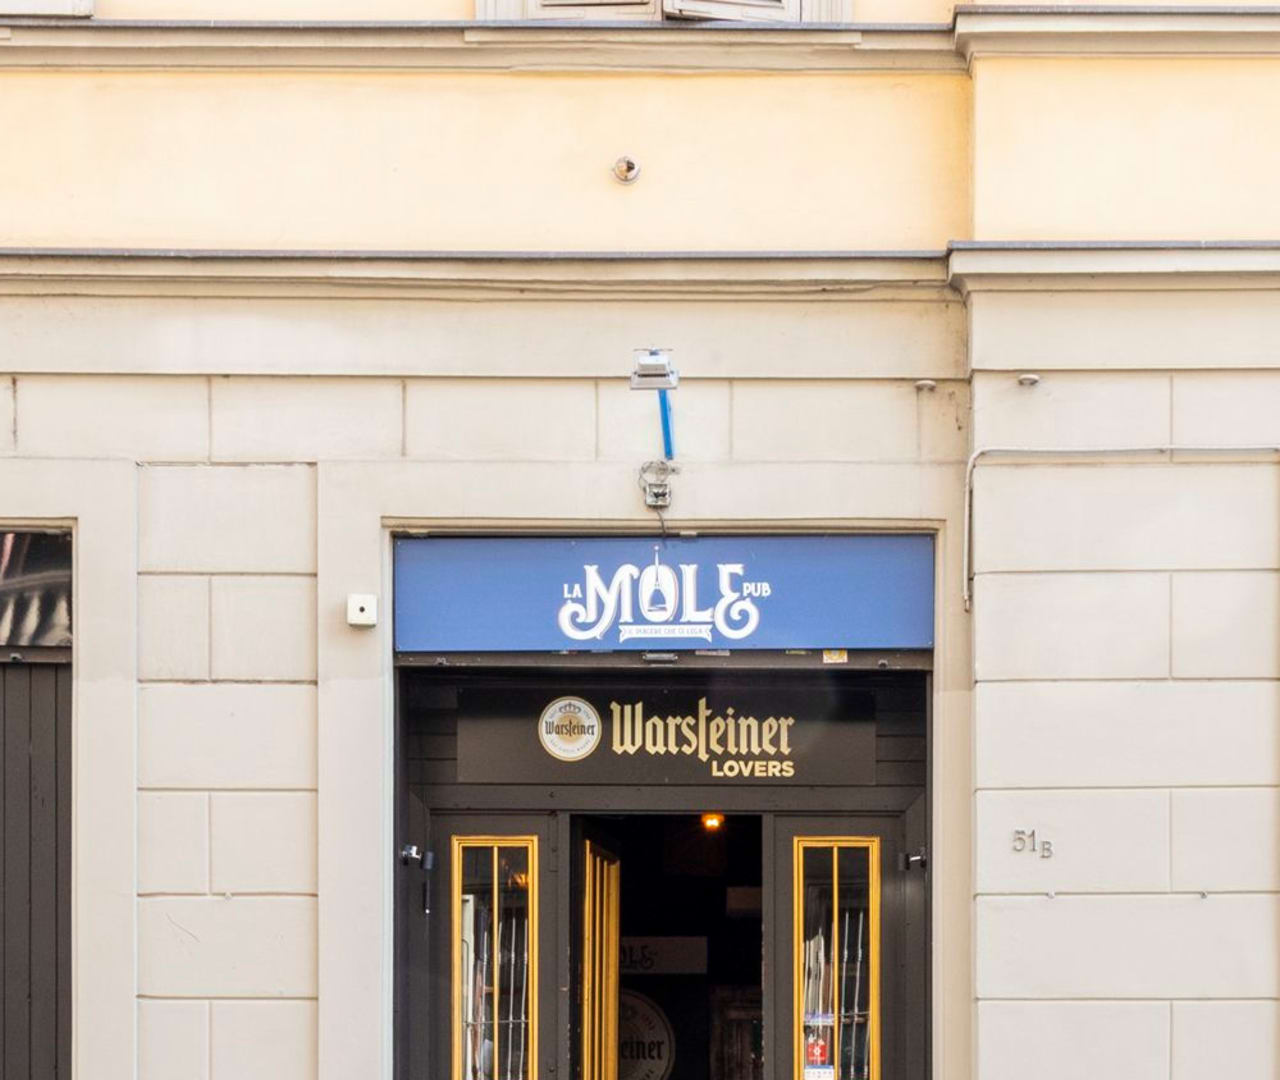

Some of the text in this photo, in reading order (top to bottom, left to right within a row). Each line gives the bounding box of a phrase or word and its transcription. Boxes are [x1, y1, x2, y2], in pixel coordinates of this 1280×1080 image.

[558, 562, 772, 640] LA MOLE PUB
[545, 720, 596, 737] Warsteiner
[609, 696, 796, 762] Warsteiner
[711, 760, 796, 777] LOVERS
